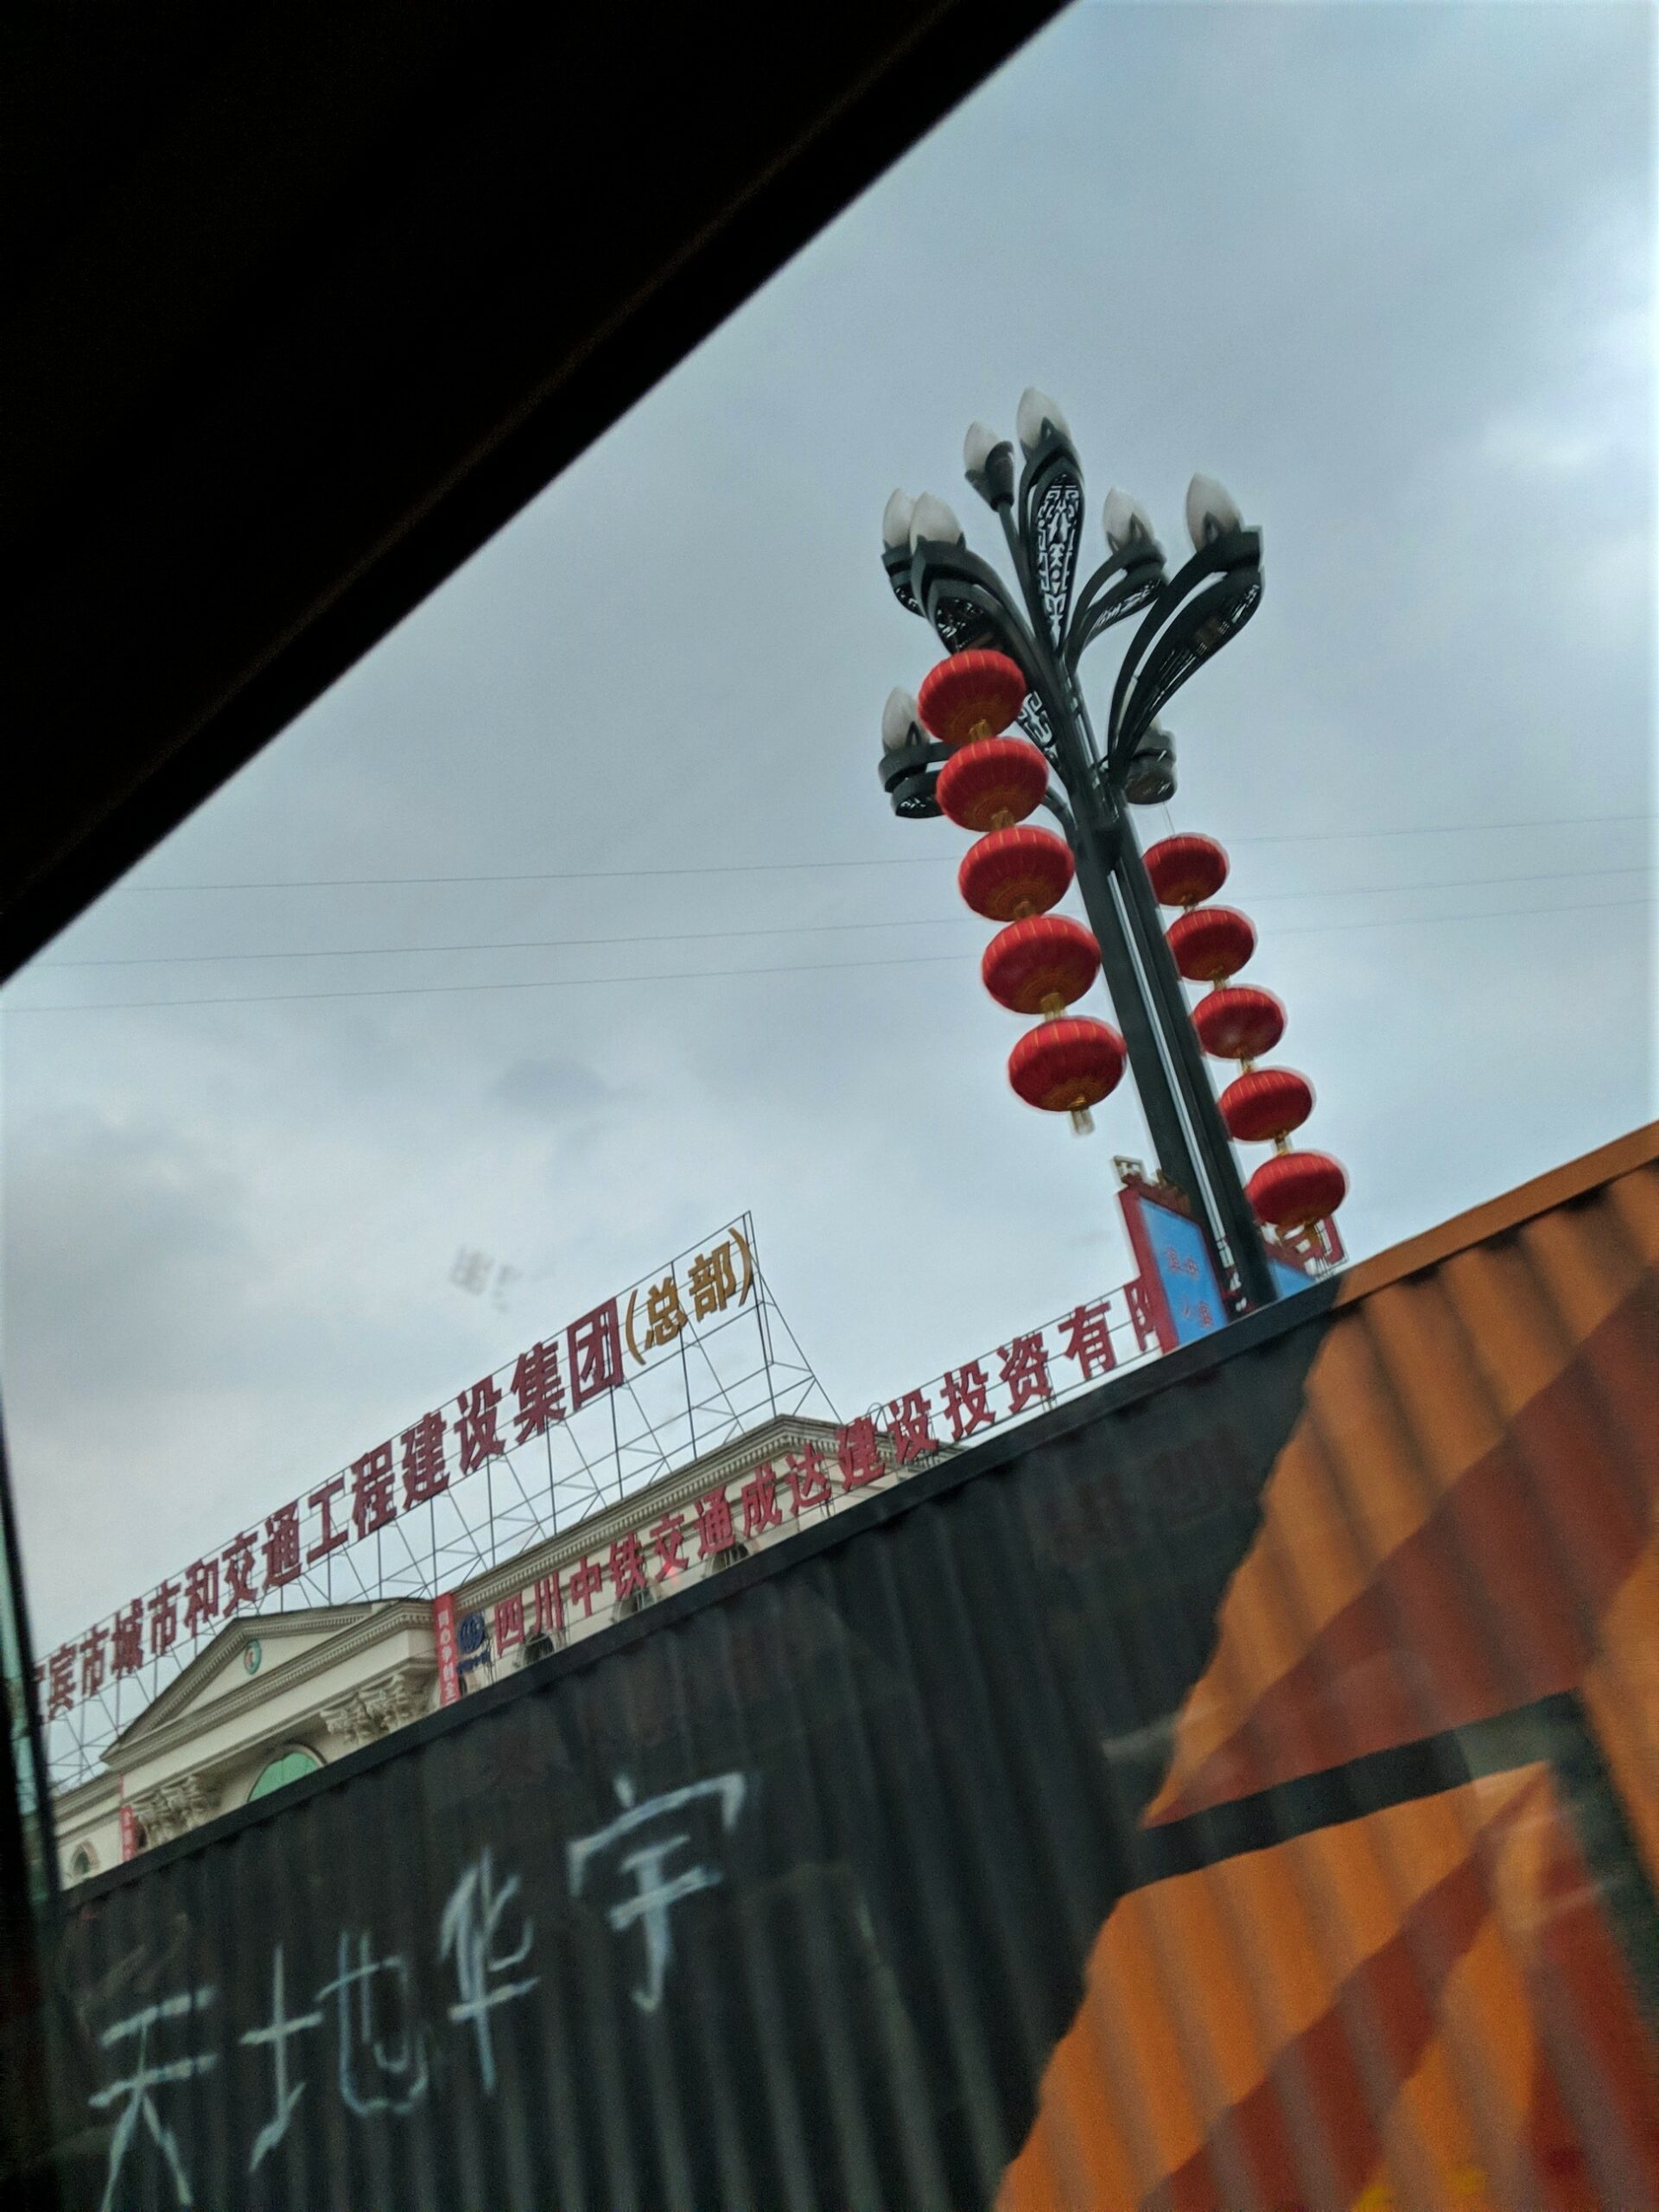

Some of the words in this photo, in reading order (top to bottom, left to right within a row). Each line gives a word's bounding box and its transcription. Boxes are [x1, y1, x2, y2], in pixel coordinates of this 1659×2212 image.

[35, 1227, 753, 1721] 宾市城市和交通工程建设集团(总部)
[88, 1773, 747, 2212] 天地华宇
